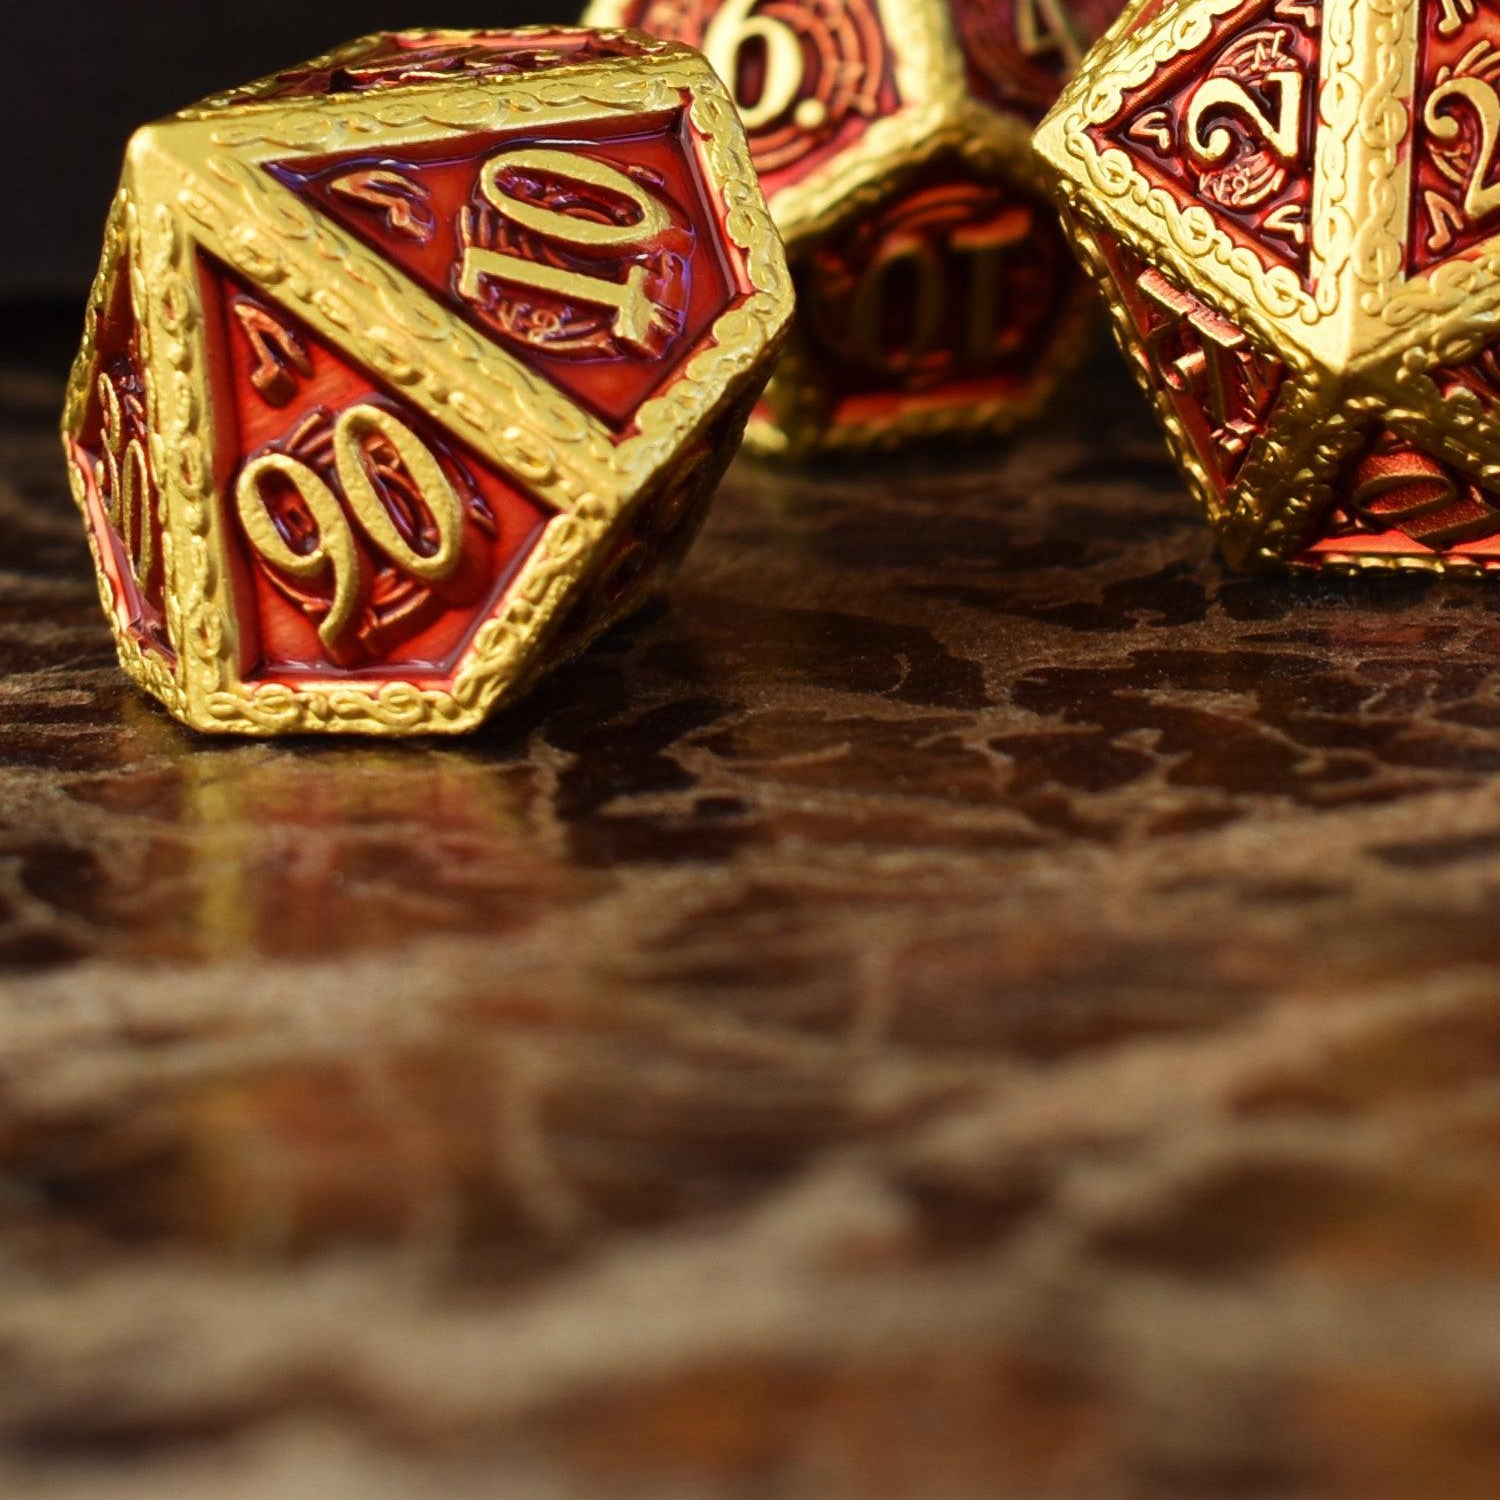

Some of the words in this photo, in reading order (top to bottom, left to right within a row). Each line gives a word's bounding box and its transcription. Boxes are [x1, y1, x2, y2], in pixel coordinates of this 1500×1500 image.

[1185, 70, 1301, 159] 2
[457, 148, 681, 355] 10
[235, 405, 462, 661] 90
